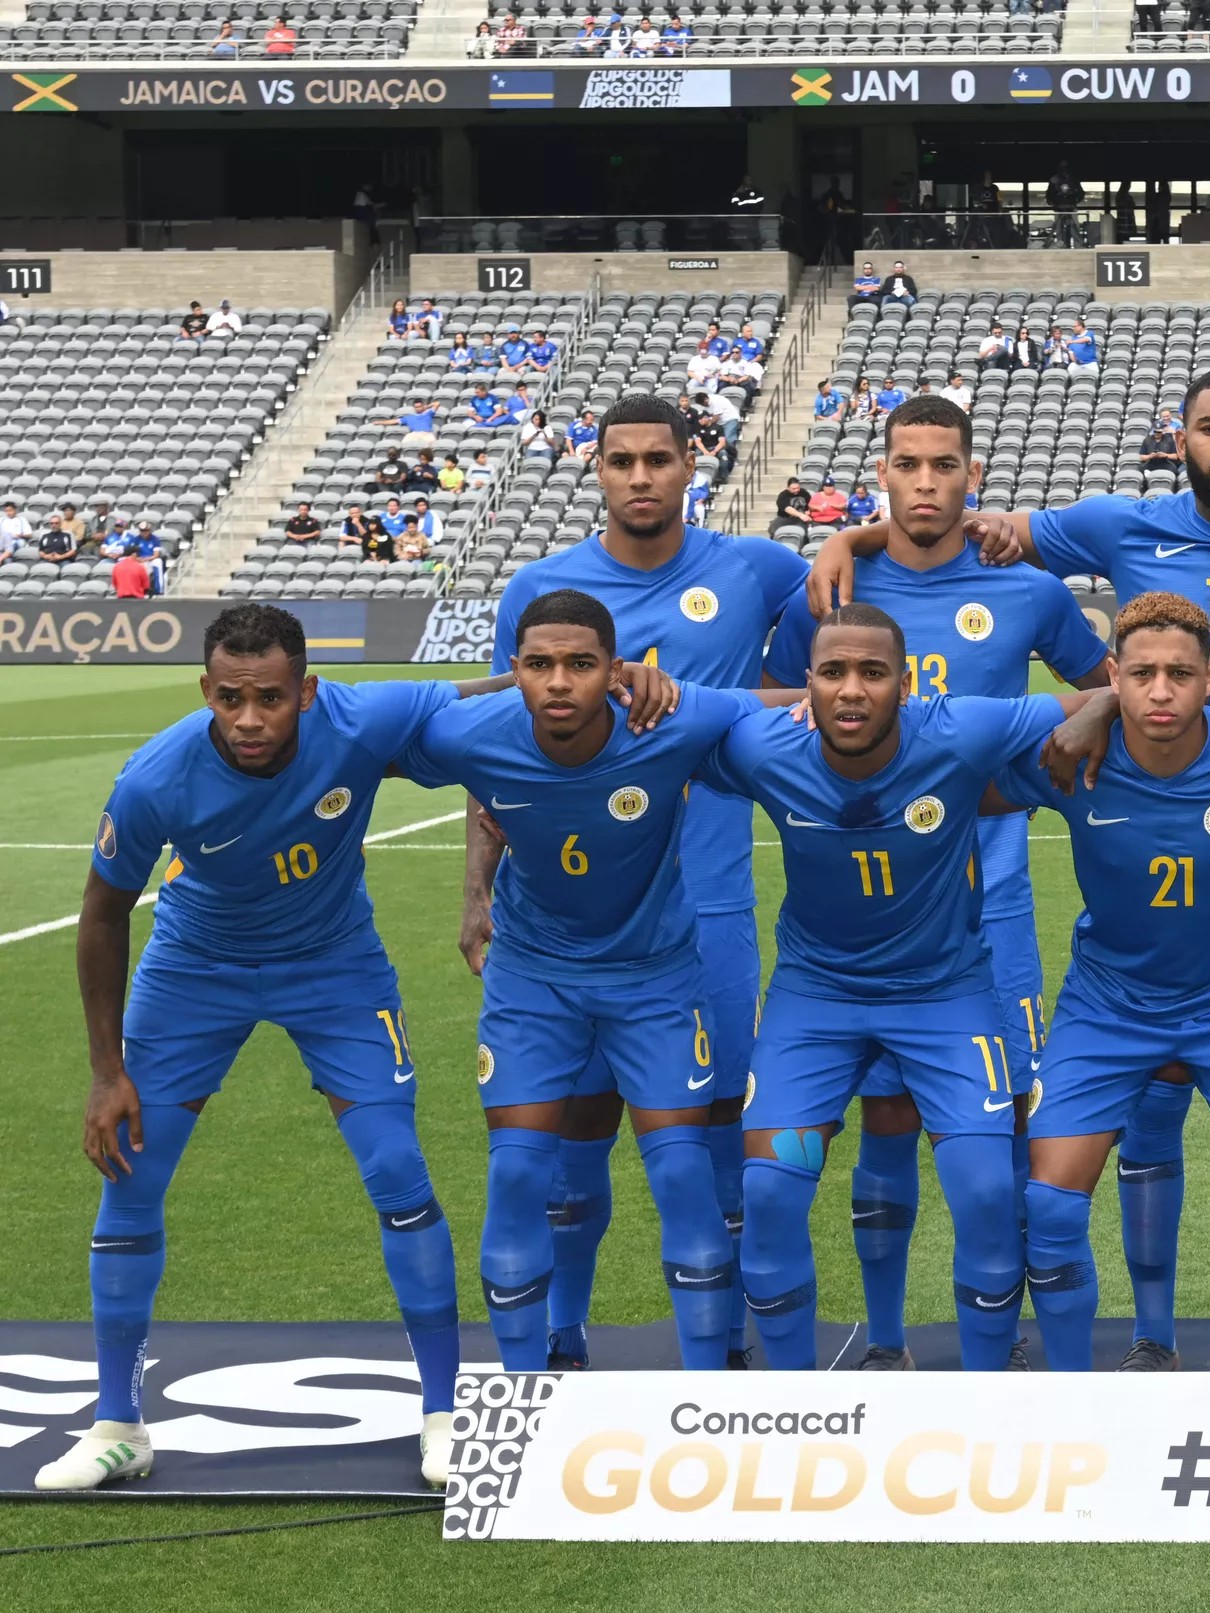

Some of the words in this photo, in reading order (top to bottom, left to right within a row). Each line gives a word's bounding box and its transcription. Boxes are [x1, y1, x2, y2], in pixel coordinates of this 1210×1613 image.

[120, 79, 248, 105] JAMAICA
[257, 79, 295, 105] VS
[304, 79, 447, 110] CURAÇAO
[841, 70, 919, 103] JAM
[950, 69, 976, 103] 0
[1060, 68, 1156, 100] CUW
[1166, 67, 1191, 101] 0
[7, 267, 42, 289] 111
[485, 267, 524, 288] 112
[670, 261, 709, 269] FIGUEROA
[710, 261, 717, 269] A
[1103, 261, 1143, 282] 113
[906, 653, 947, 700] 13
[268, 842, 318, 884] 10
[560, 834, 589, 876] 6
[851, 850, 895, 896] 11
[1149, 856, 1195, 907] 21
[694, 1009, 711, 1068] 6
[972, 1035, 1012, 1094] 11
[454, 1375, 560, 1408] GOLD
[670, 1402, 866, 1435] Concacaf
[561, 1430, 867, 1515] GOLD
[883, 1430, 1108, 1516] CUP
